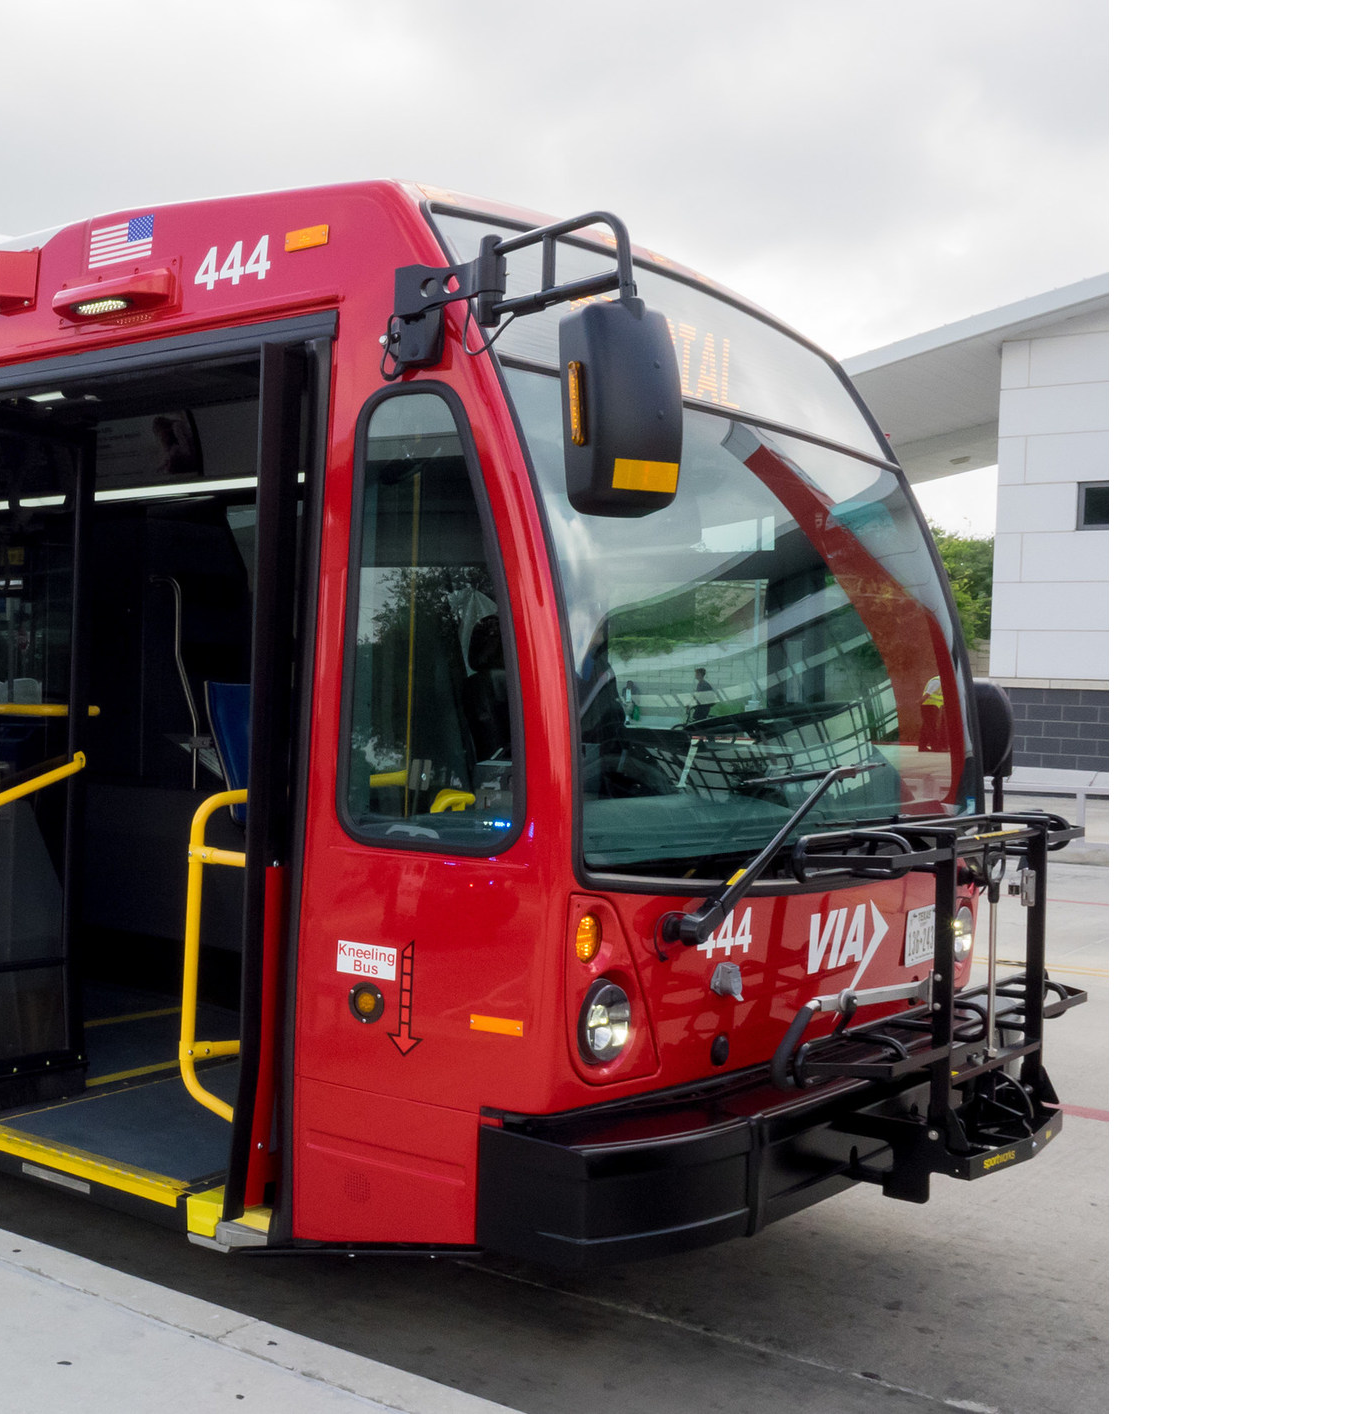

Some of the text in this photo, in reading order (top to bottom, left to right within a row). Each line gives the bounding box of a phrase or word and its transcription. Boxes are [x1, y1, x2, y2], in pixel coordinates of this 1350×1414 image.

[194, 234, 271, 291] 444
[338, 943, 396, 967] Kneeling
[807, 903, 866, 975] VIA
[353, 959, 379, 975] Bus
